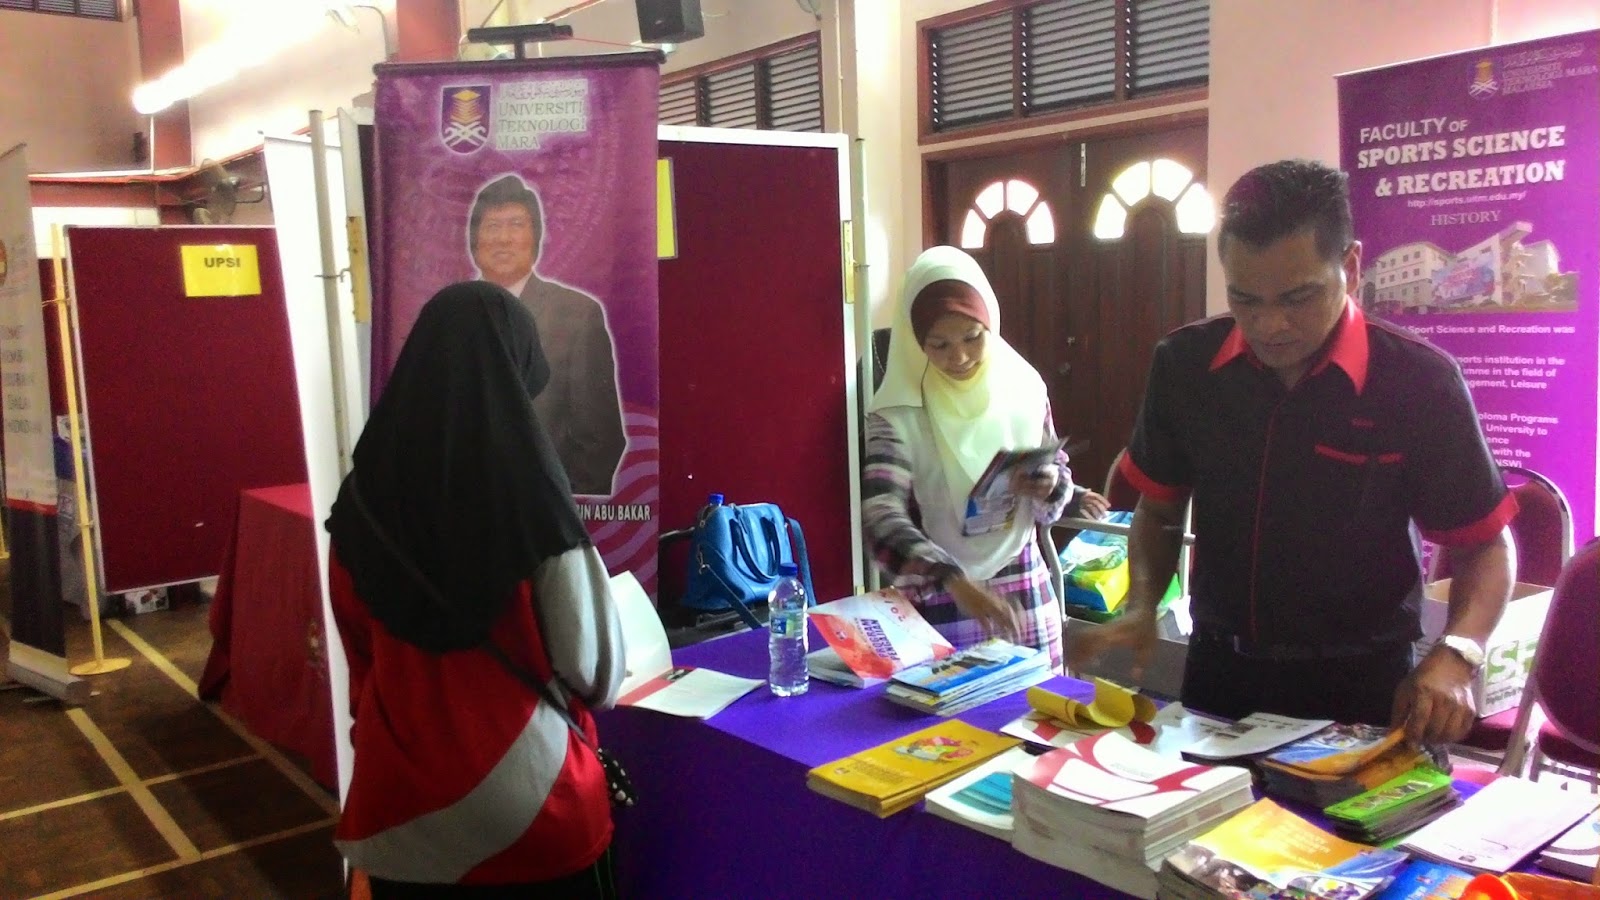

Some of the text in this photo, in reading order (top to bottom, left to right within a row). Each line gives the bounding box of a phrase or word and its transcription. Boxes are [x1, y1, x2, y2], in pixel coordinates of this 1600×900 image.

[499, 101, 584, 116] UNIVERSITI
[498, 118, 586, 134] TEKNOLOGI
[1360, 117, 1469, 143] FACULTY OF
[498, 136, 540, 149] MARA
[1357, 125, 1566, 169] SPORTS SCIENCE
[1375, 159, 1566, 198] & RECREATION
[1430, 210, 1501, 226] HISTORY
[204, 257, 242, 268] UPSI
[1408, 325, 1434, 335] Sport
[1436, 325, 1475, 334] Science
[1478, 325, 1496, 334] and
[1499, 325, 1551, 334] Recreation
[1457, 356, 1565, 366] ports institution in the
[1492, 368, 1502, 376] in
[1504, 368, 1520, 376] the
[1522, 368, 1543, 377] field
[1545, 369, 1557, 377] of
[1511, 380, 1548, 389] Leisure
[1510, 413, 1559, 425] Programs
[1486, 424, 1548, 436] University to
[1492, 448, 1531, 458] with the
[576, 504, 651, 520] IN ABU BAKAR
